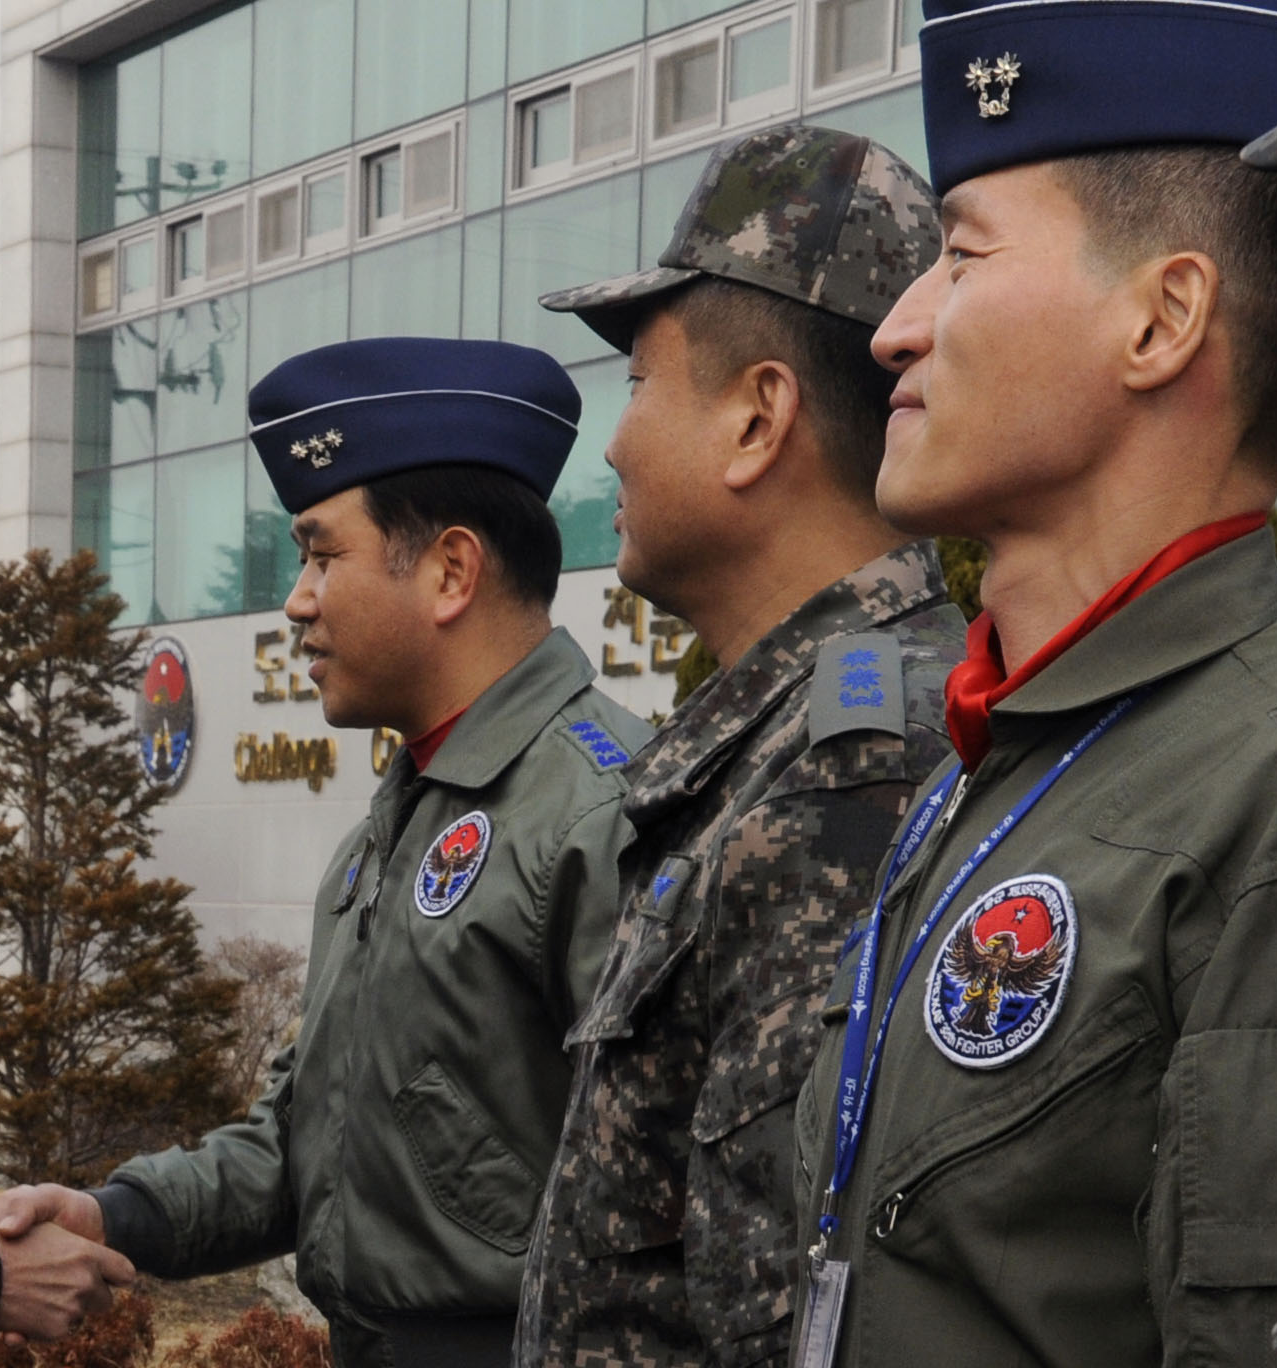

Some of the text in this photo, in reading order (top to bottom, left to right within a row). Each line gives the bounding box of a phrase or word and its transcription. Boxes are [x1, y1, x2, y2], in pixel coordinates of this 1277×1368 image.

[955, 1038, 1004, 1055] FIGHTER
[1006, 1007, 1042, 1047] GROUP
[842, 1076, 857, 1107] KF-16
